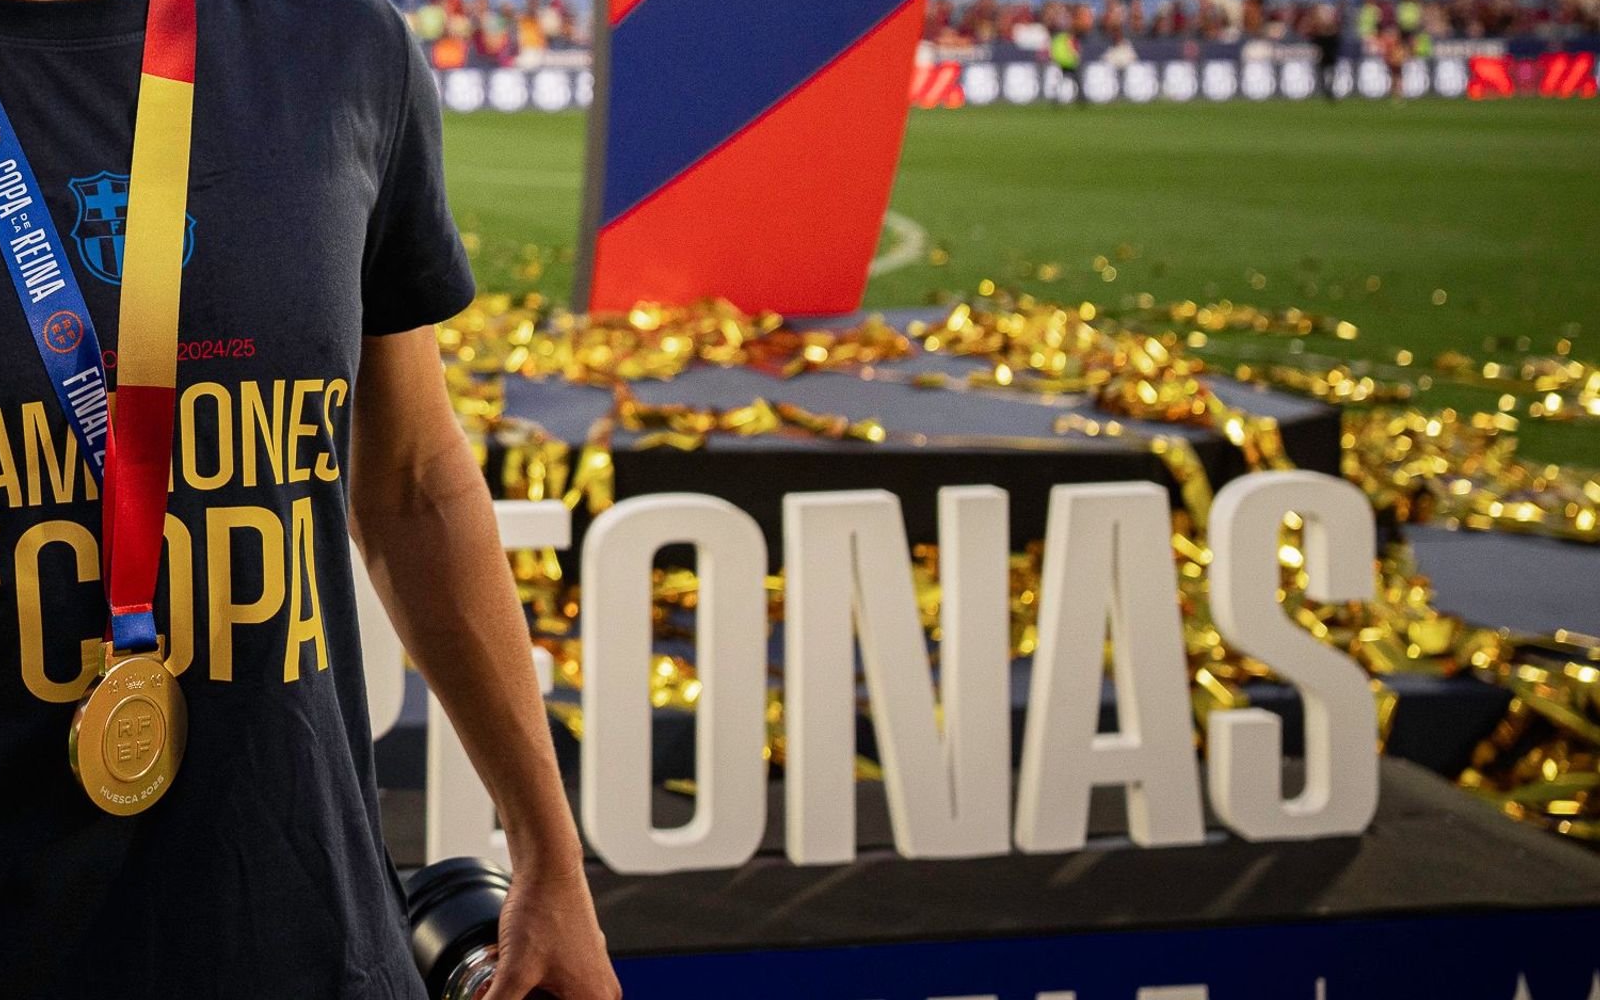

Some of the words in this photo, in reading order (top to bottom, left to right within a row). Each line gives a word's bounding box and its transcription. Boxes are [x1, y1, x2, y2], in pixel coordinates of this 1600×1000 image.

[10, 216, 22, 234] LA
[19, 213, 32, 229] DE
[10, 227, 67, 304] REINA
[177, 338, 256, 361] 2024/25
[62, 365, 108, 447] FINAL
[100, 785, 139, 804] HUESCA
[141, 775, 165, 799] 2025
